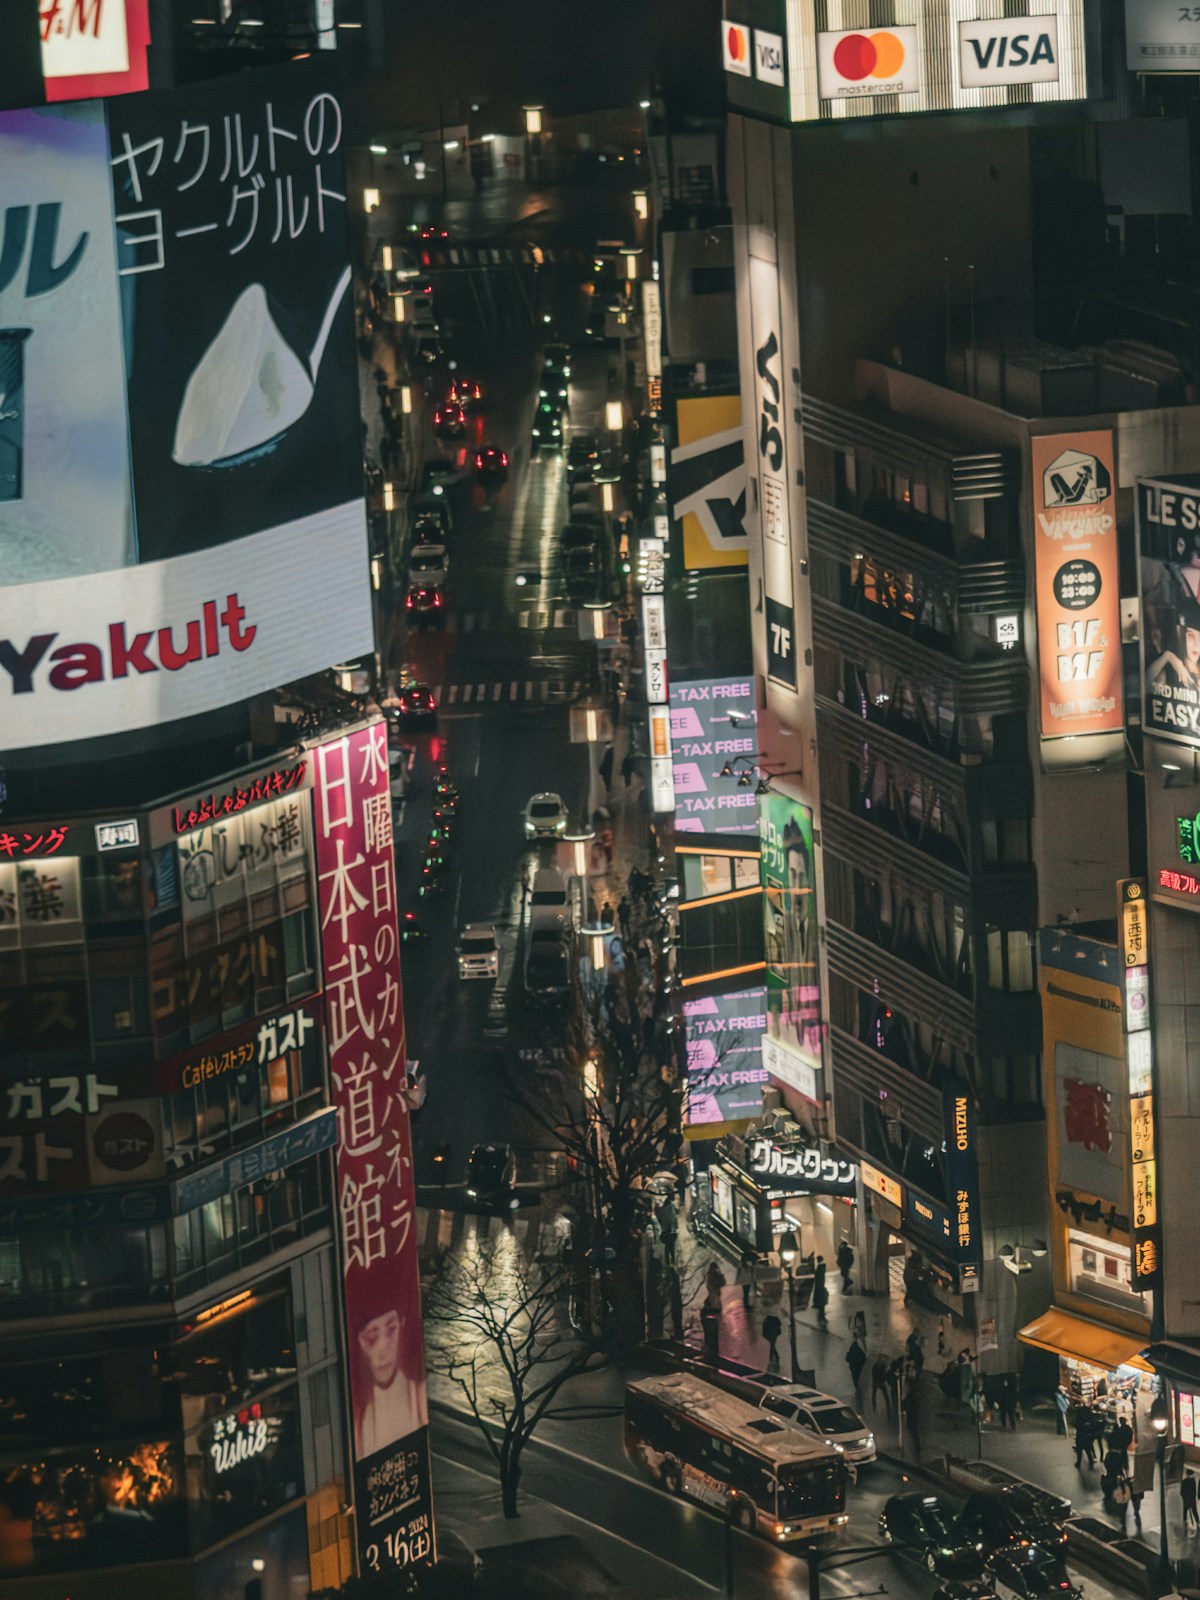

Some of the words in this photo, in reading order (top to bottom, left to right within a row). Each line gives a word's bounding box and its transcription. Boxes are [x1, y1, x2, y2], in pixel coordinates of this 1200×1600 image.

[964, 33, 1055, 69] VISA
[837, 81, 904, 94] mastercard
[110, 93, 342, 201] ヤクルトの
[114, 164, 346, 276] ヨーグルト
[1146, 489, 1175, 527] LE
[1062, 572, 1096, 586] 10:00
[0, 593, 257, 694] Yakult
[771, 622, 791, 659] 7F
[1057, 619, 1101, 650] B1F
[650, 661, 662, 701] スシロー
[1057, 651, 1105, 682] B2F
[678, 687, 709, 701] TAX
[712, 684, 750, 698] FREE
[1173, 686, 1198, 704] MINI
[1152, 699, 1200, 730] EASY
[681, 742, 712, 756] TAX
[715, 739, 752, 754] FREE
[684, 797, 715, 811] TAX
[718, 794, 756, 808] FREE
[318, 736, 387, 1270] 日本武道館
[359, 727, 413, 1256] 水曜日のカンパネラ
[258, 1008, 314, 1065] ガスト
[695, 1018, 727, 1033] TAX
[729, 1014, 767, 1030] FREE
[5, 1073, 118, 1120] ガスト
[698, 1072, 729, 1088] TAX
[731, 1069, 769, 1085] FREE
[955, 1096, 968, 1151] MIZUHO
[750, 1140, 856, 1184] グルメタウン
[957, 1189, 970, 1247] みずほ銀行
